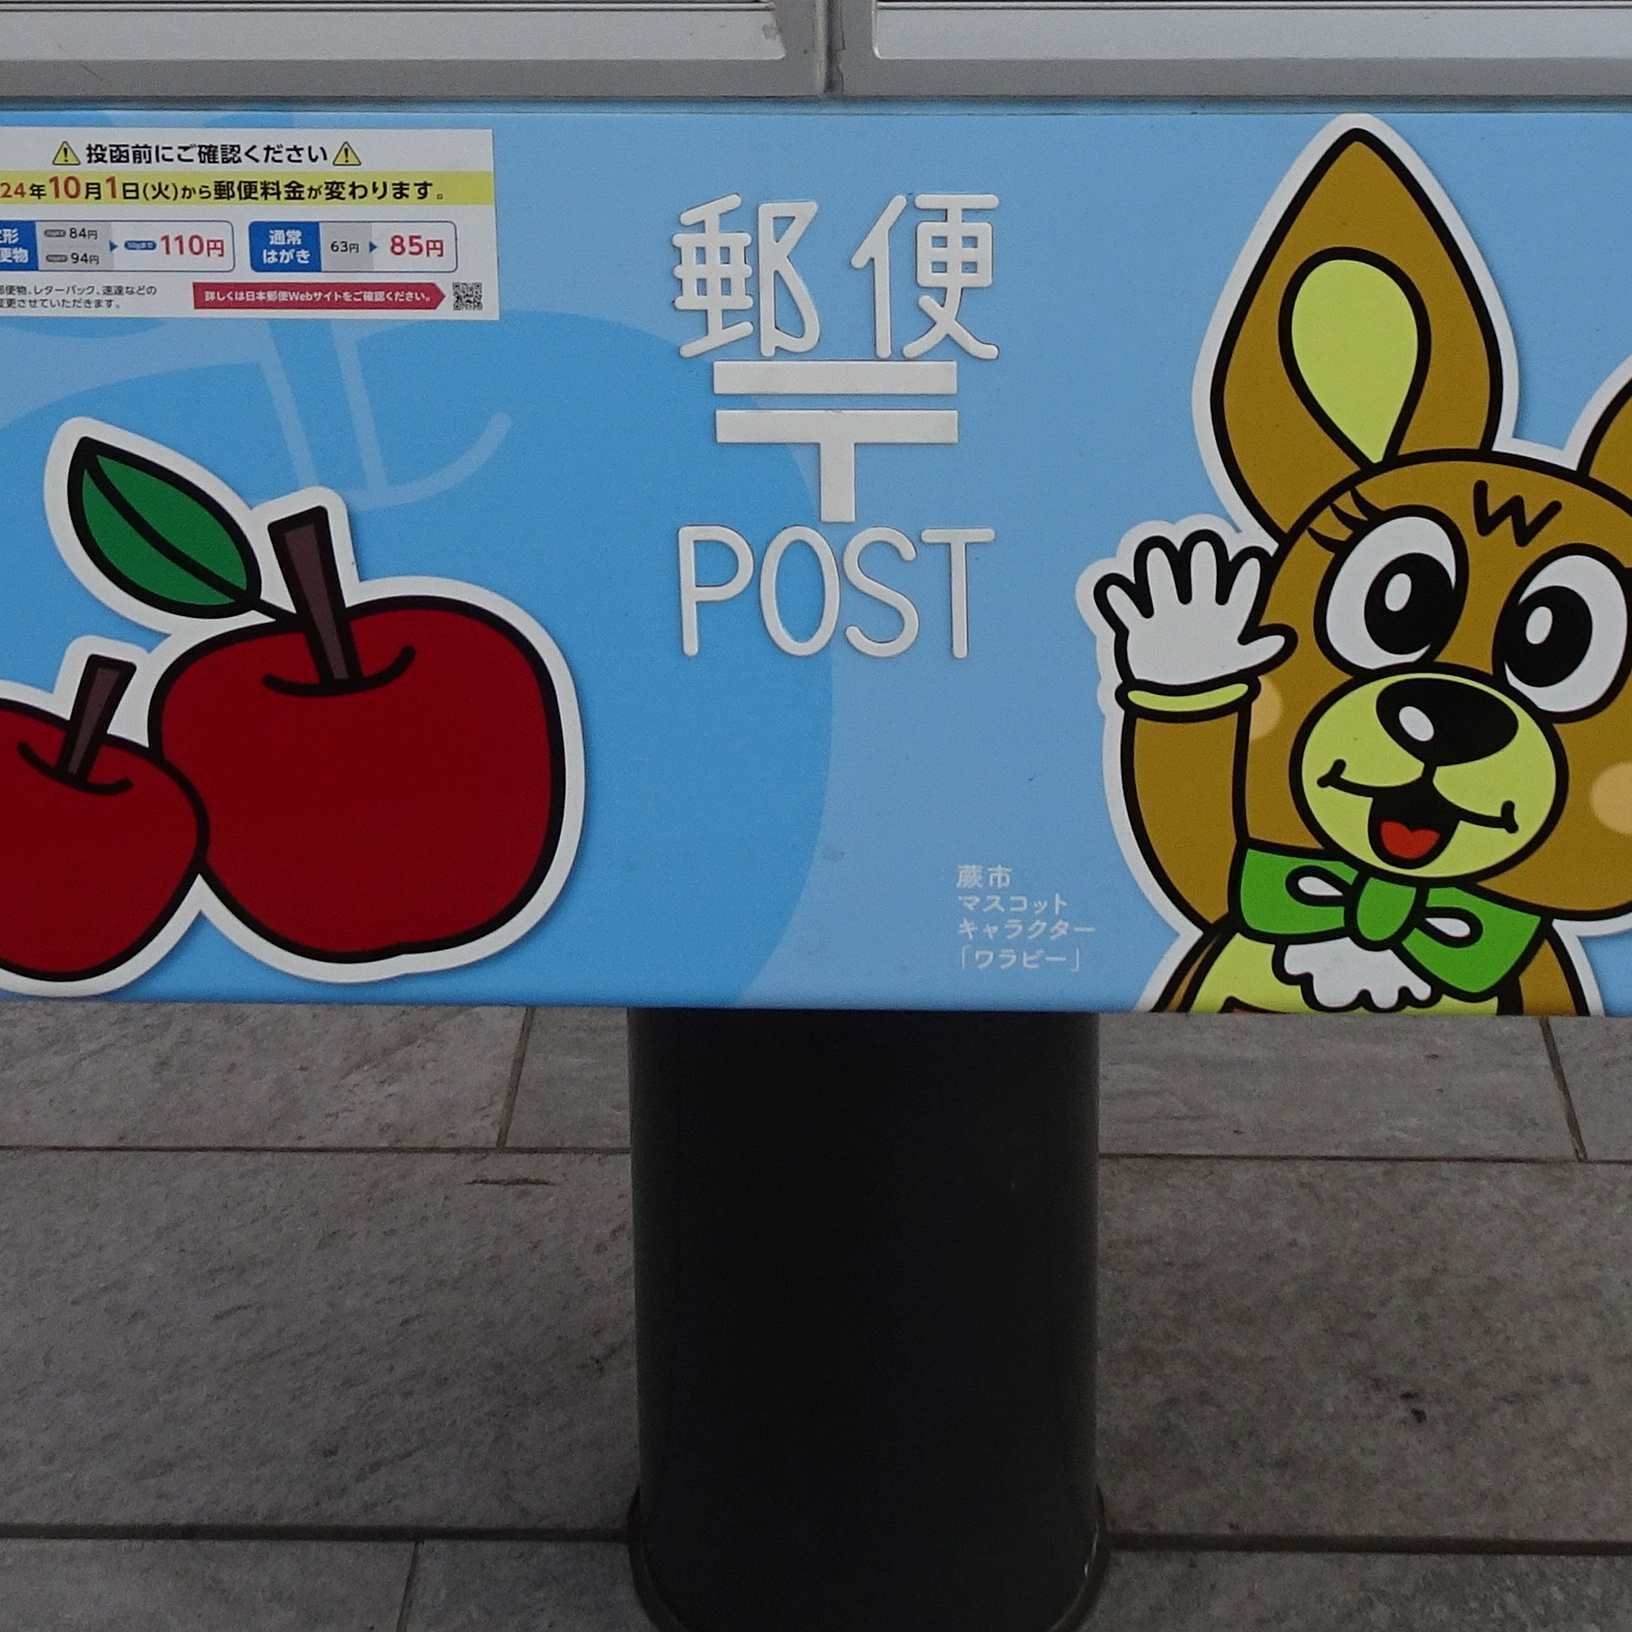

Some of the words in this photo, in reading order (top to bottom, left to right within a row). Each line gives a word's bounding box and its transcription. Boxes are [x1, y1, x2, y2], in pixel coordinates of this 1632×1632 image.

[86, 142, 328, 165] 投函前にご確認ください
[68, 227, 98, 241] 84円
[268, 229, 303, 246] 通常
[159, 234, 226, 258] 110円
[262, 248, 311, 265] はがき
[329, 240, 360, 254] 63円
[388, 234, 445, 258] 85円
[70, 252, 101, 266] 94円
[671, 192, 1000, 359] 郵便
[677, 524, 997, 659] POST
[955, 864, 1014, 889] 蕨市
[957, 892, 1068, 915] マスコット
[958, 917, 1097, 941] キャラクター
